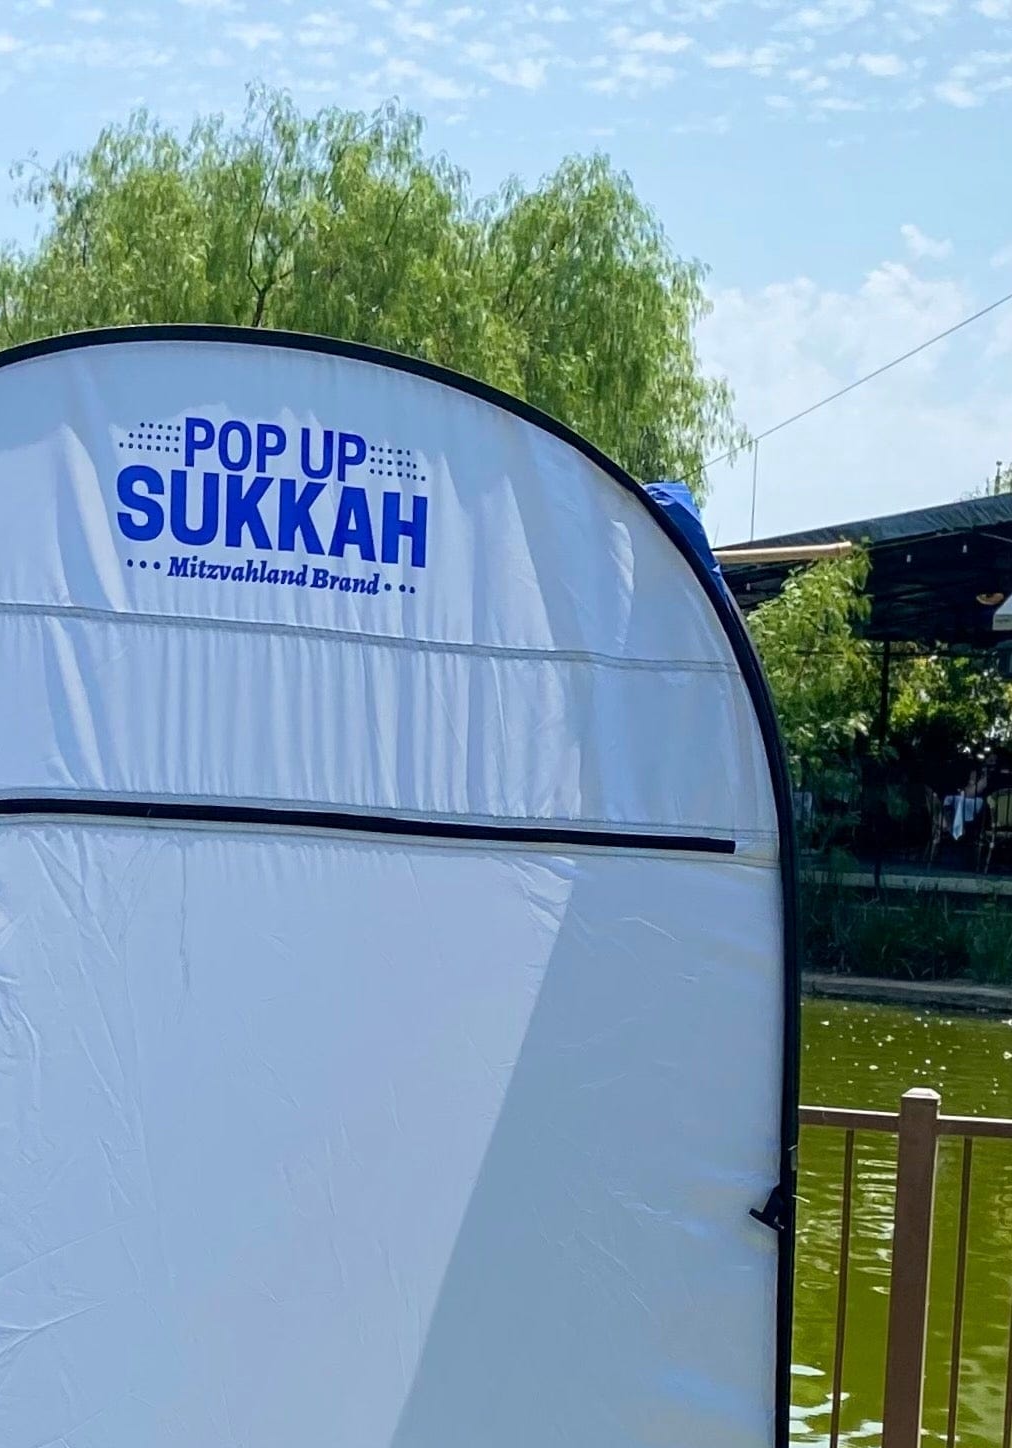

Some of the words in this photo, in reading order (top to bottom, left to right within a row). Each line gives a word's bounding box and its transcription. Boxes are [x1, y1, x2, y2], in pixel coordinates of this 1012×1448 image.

[185, 417, 286, 472] POP
[301, 428, 366, 482] UP
[117, 465, 427, 568] SUKKAH
[167, 556, 307, 586] Mitzvahland
[310, 568, 379, 595] Brand
